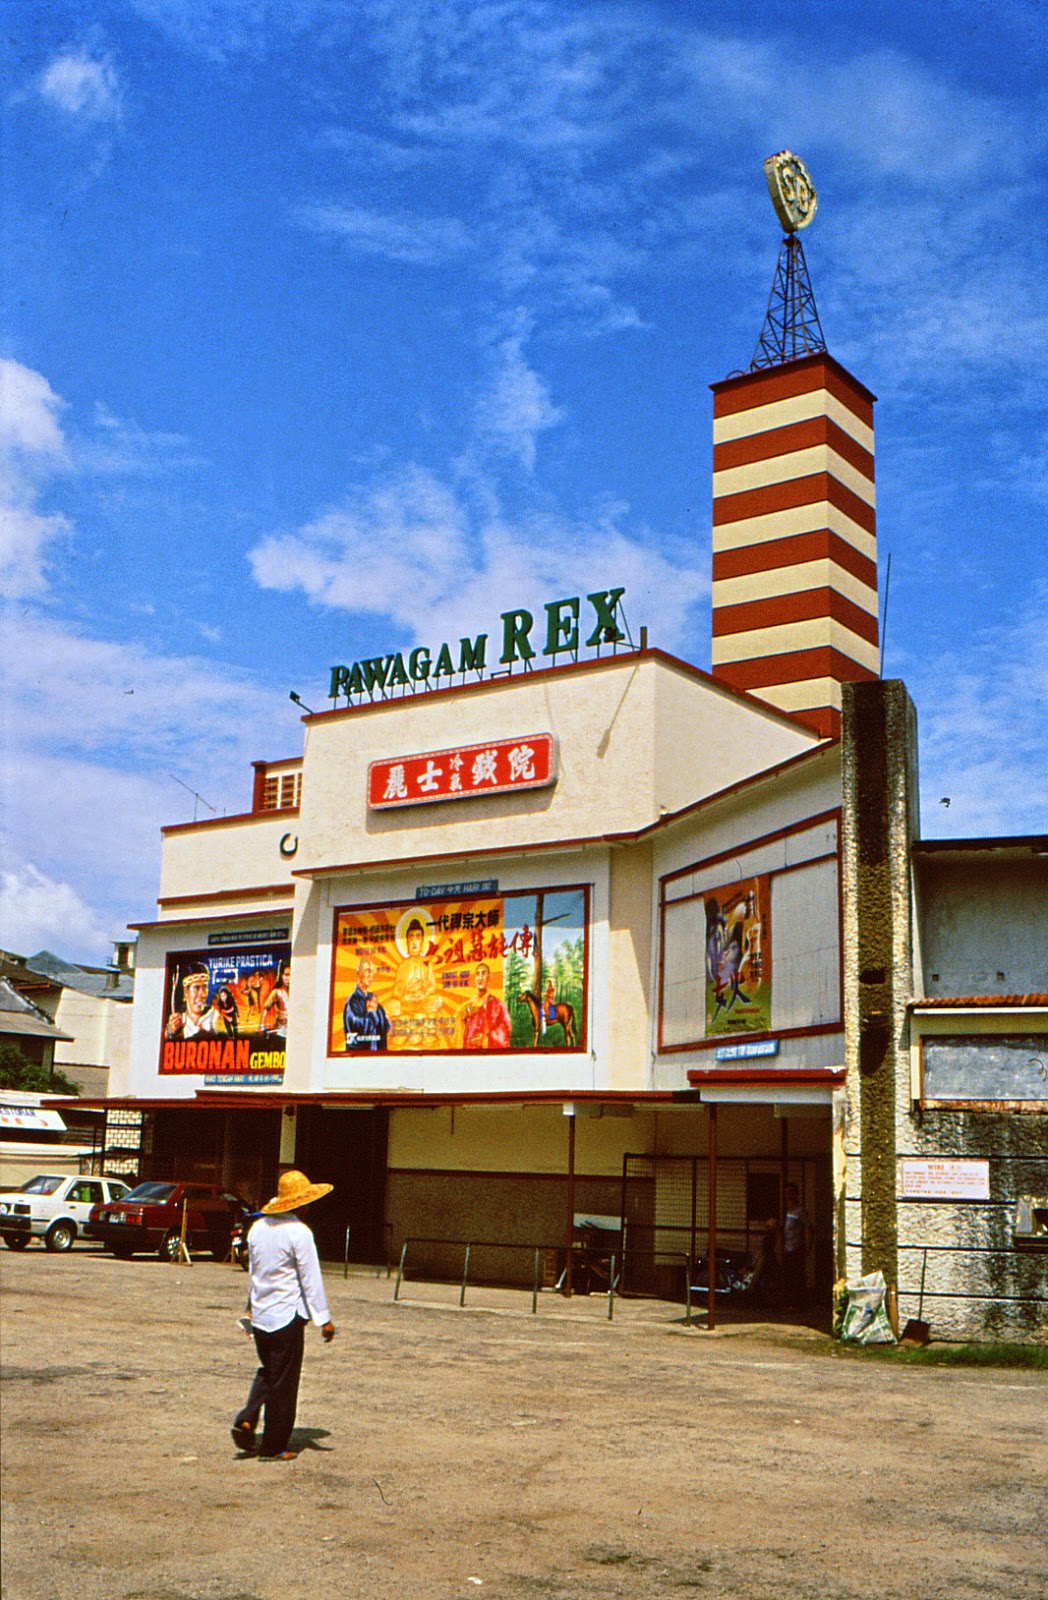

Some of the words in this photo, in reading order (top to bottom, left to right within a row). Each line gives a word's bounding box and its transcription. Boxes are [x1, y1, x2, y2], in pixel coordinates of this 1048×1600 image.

[328, 634, 488, 698] PAWAGAM
[499, 587, 625, 664] REX
[164, 1040, 250, 1070] BURONAN
